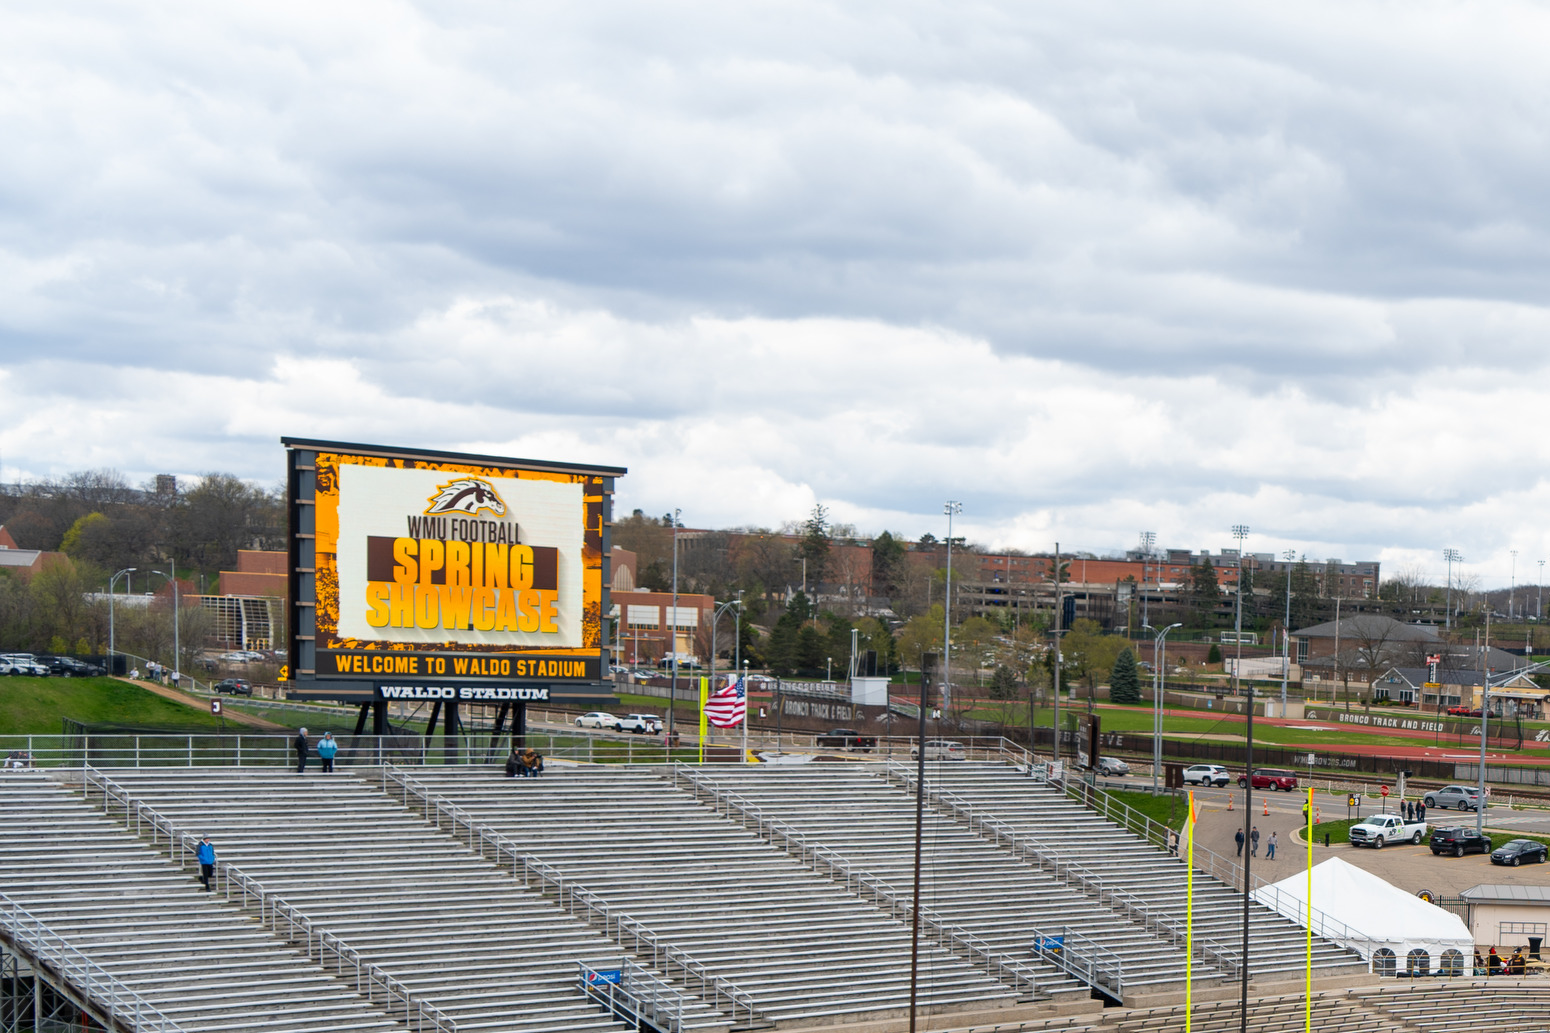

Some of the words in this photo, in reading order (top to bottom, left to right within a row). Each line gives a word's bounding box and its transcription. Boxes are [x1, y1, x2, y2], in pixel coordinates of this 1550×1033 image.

[408, 515, 447, 540] WMU
[452, 518, 522, 545] FOOTBALL
[393, 537, 534, 590] SPRING
[365, 584, 559, 633] SHOWCASE
[335, 655, 418, 675] WELCOME
[426, 657, 446, 675] TO
[454, 659, 510, 676] WALDO
[517, 660, 586, 678] STADIUM
[381, 686, 455, 698] WALDO
[460, 688, 549, 700] STADIUM
[213, 701, 220, 713] J
[760, 708, 767, 718] L
[784, 700, 809, 716] BRONCO
[811, 703, 830, 719] TRACK
[836, 705, 852, 720] FIELD
[1339, 713, 1369, 724] BRONCO
[1373, 716, 1398, 728] TRACK
[1401, 719, 1418, 730] AND
[1421, 721, 1444, 732] FIELD
